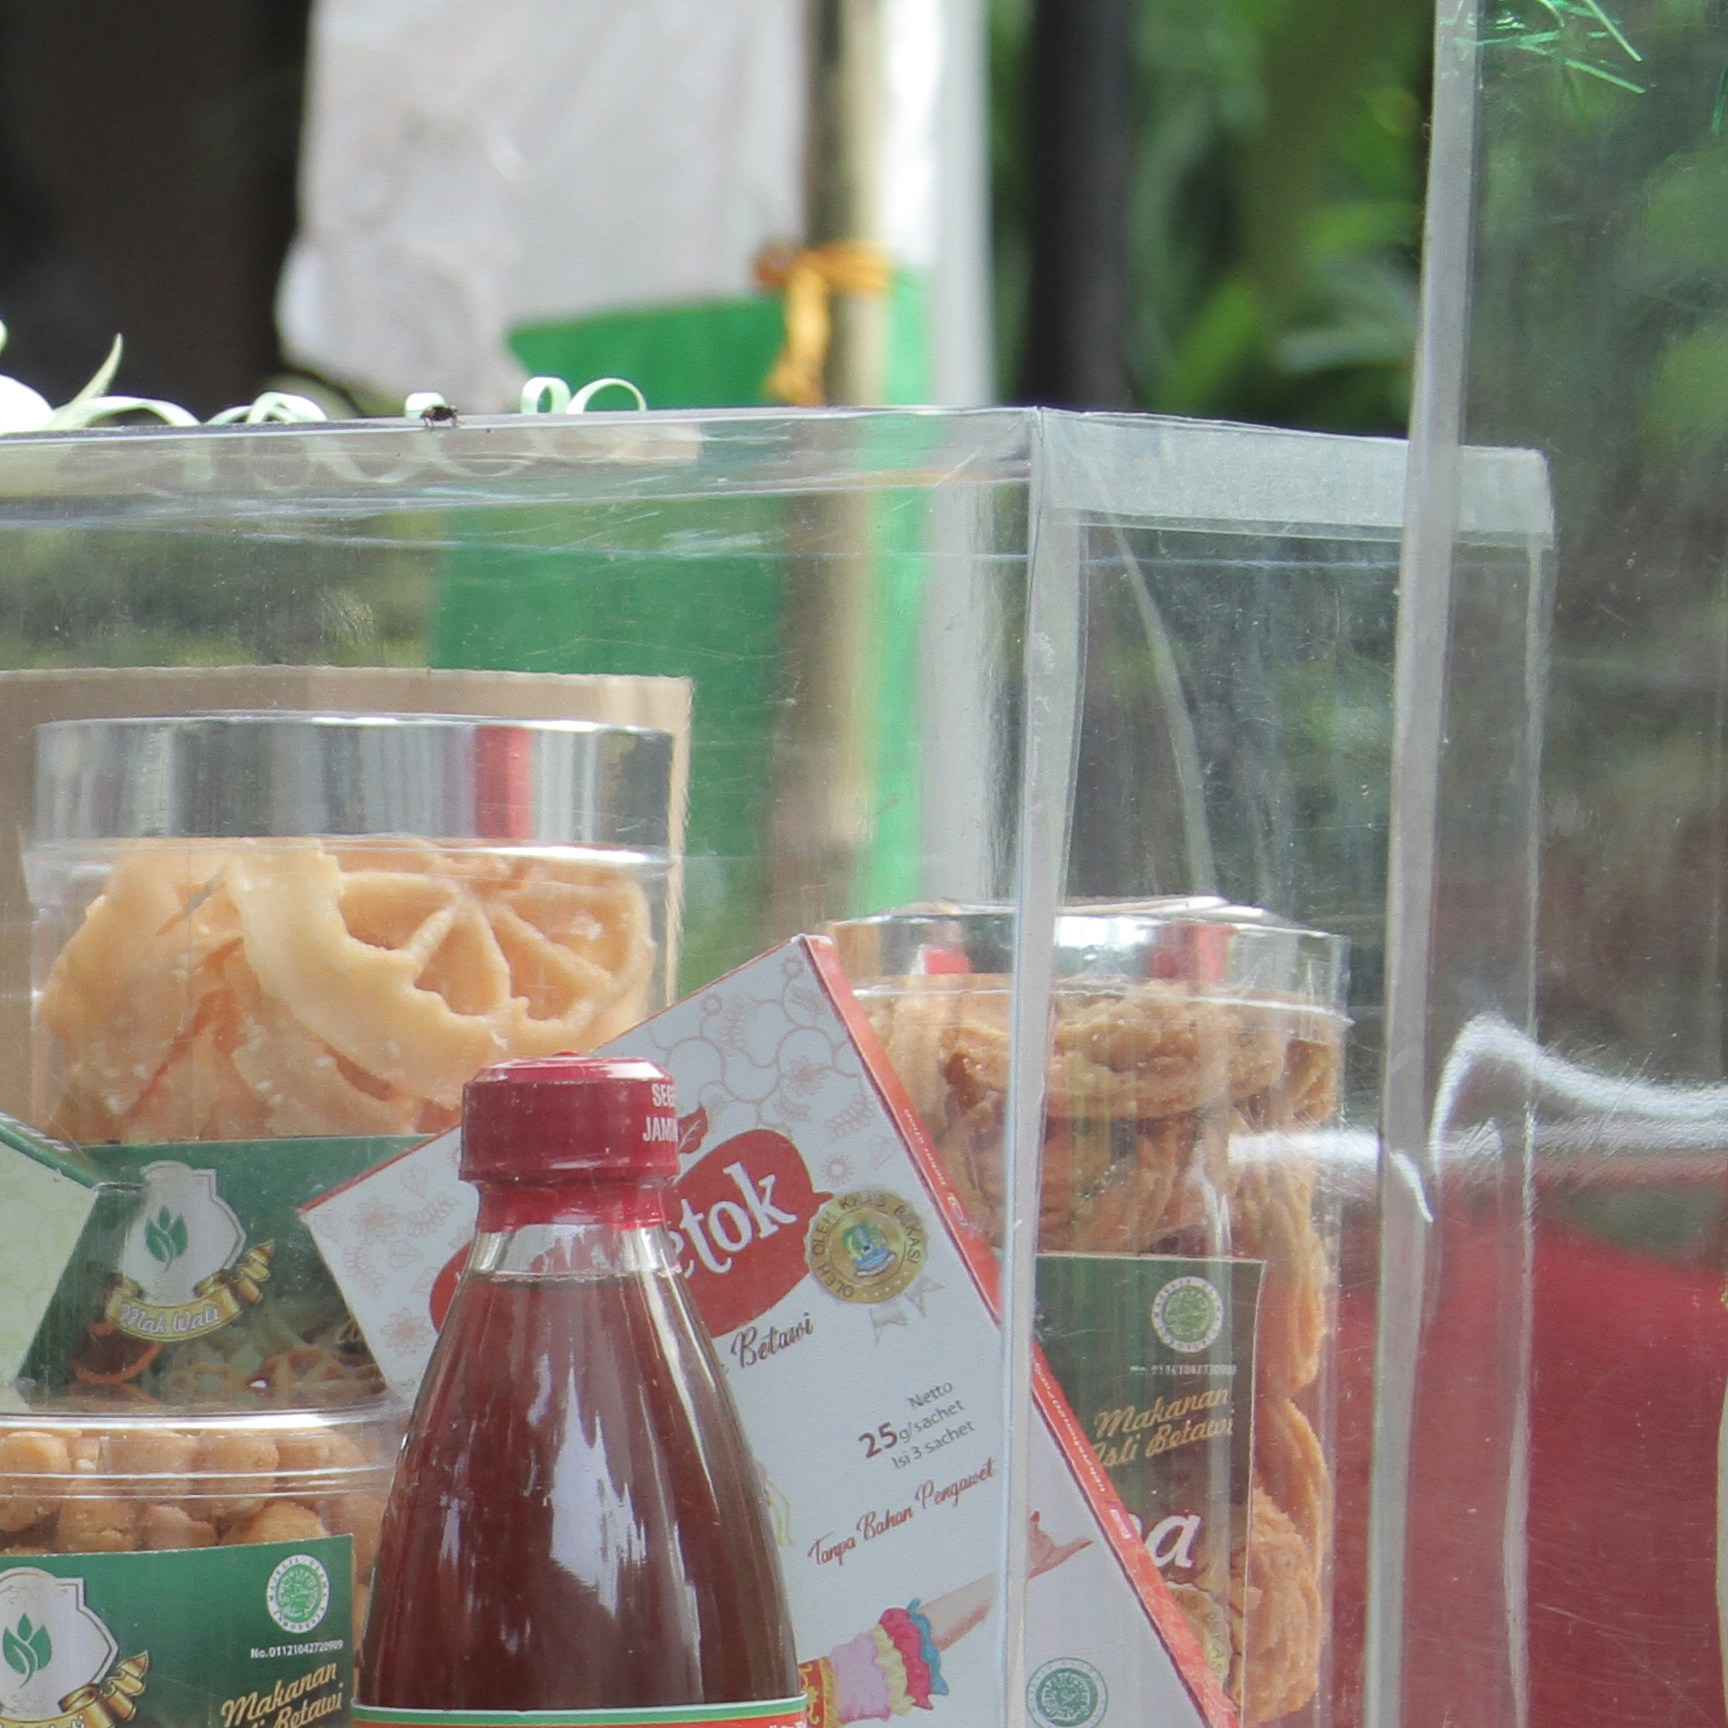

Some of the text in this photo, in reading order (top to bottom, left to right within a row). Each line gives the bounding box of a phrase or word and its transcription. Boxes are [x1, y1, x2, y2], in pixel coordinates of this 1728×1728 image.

[812, 1211, 837, 1256] OLEH
[893, 1204, 922, 1265] BEKASI
[817, 1263, 855, 1298] OLEH
[120, 1303, 167, 1335] Mak
[731, 1312, 814, 1368] Betawi
[908, 1381, 954, 1410] Netto
[1093, 1388, 1230, 1439] Makanan
[892, 1419, 976, 1471] Isi 3 sachet
[1145, 1416, 1234, 1457] Betawi
[807, 1457, 994, 1569] Tanpa Bahan Pengawet
